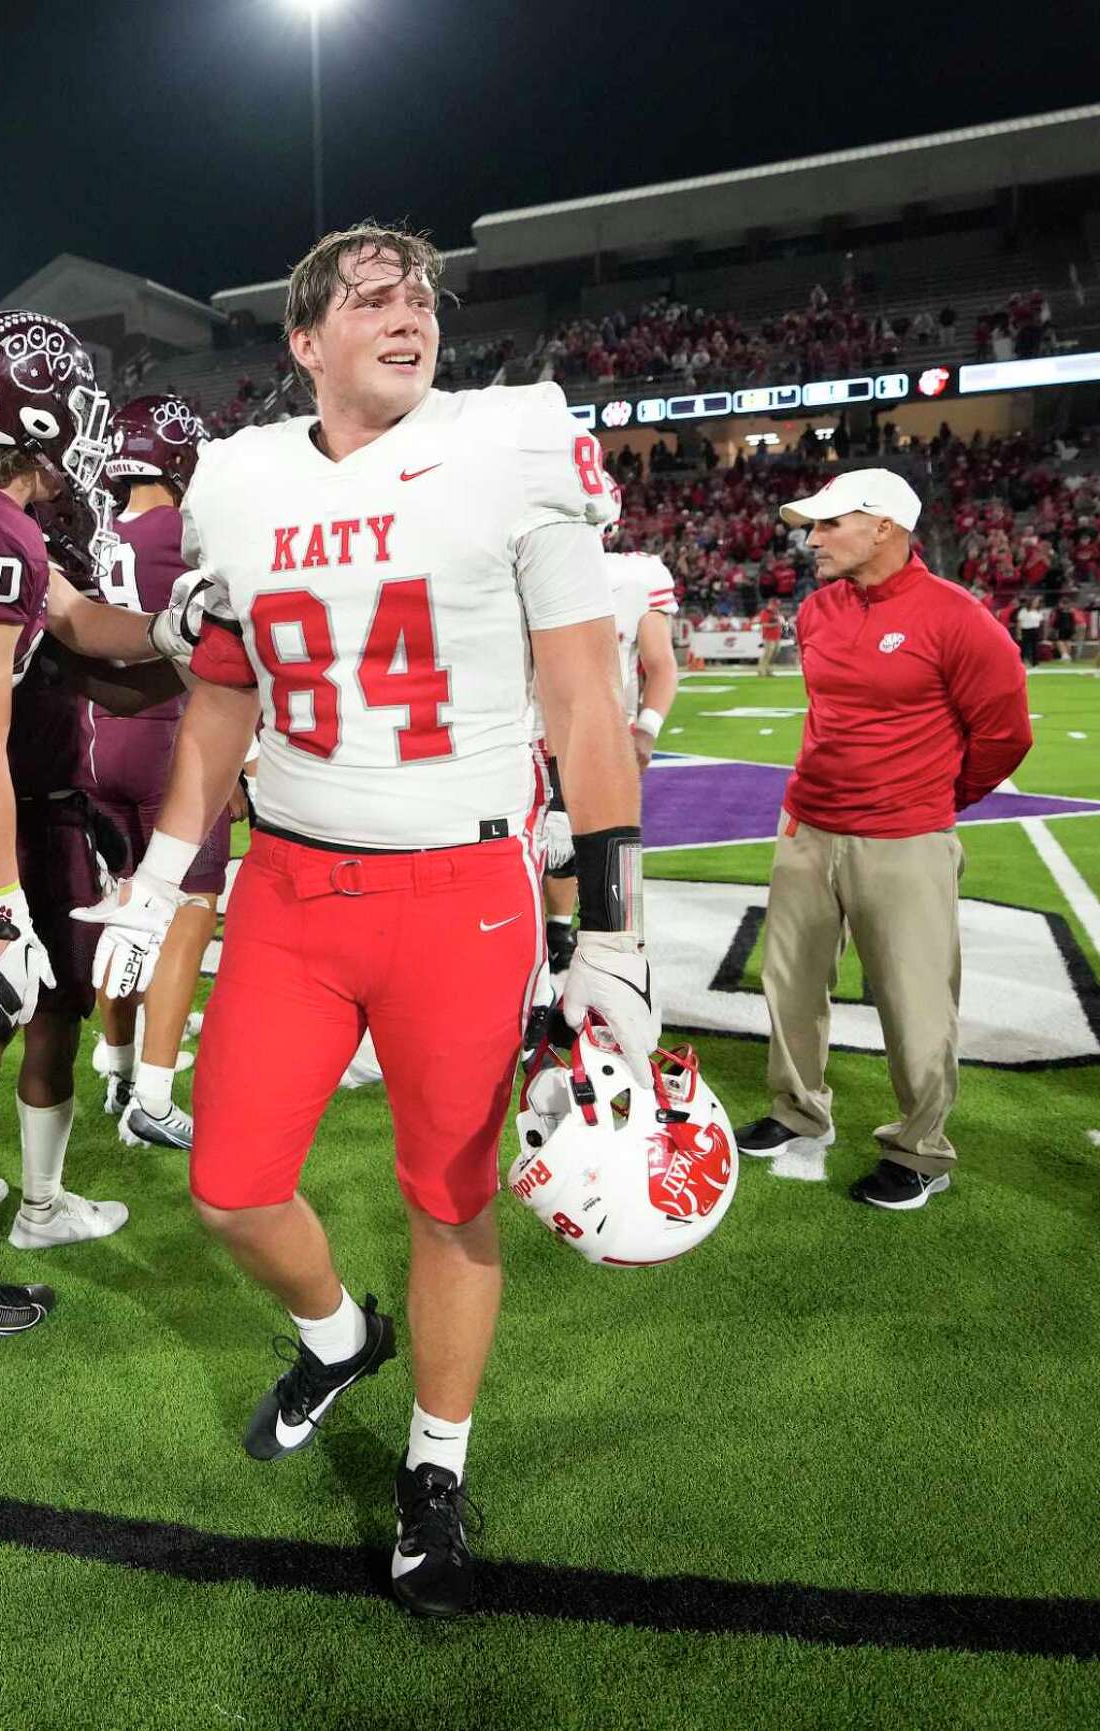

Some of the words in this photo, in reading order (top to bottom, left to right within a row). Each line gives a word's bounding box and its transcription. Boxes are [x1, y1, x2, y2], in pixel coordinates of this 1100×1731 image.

[574, 435, 603, 496] 8
[269, 513, 397, 574] KATY
[248, 573, 457, 766] 84
